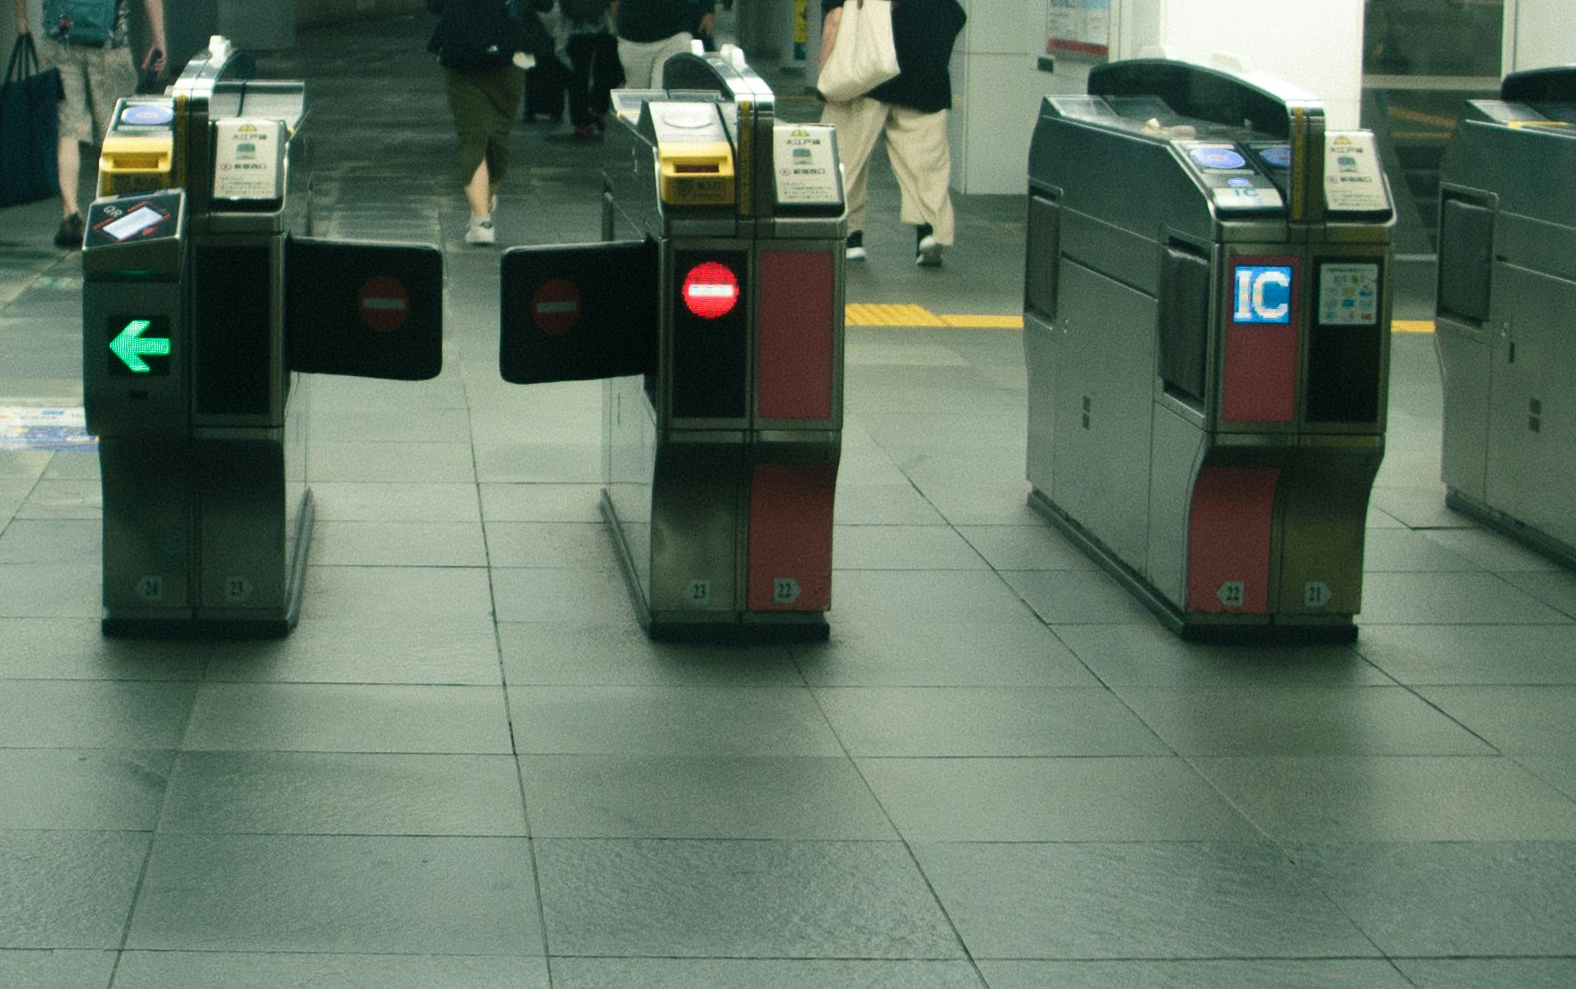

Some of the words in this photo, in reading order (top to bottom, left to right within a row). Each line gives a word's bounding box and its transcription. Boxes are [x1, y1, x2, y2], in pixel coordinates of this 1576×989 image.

[103, 205, 124, 218] QR
[1235, 269, 1290, 320] IC
[143, 580, 159, 597] 24
[229, 580, 244, 597] 23
[691, 582, 707, 600] 23
[777, 582, 794, 599] 22
[1225, 584, 1241, 603] 22
[1307, 584, 1323, 603] 21
